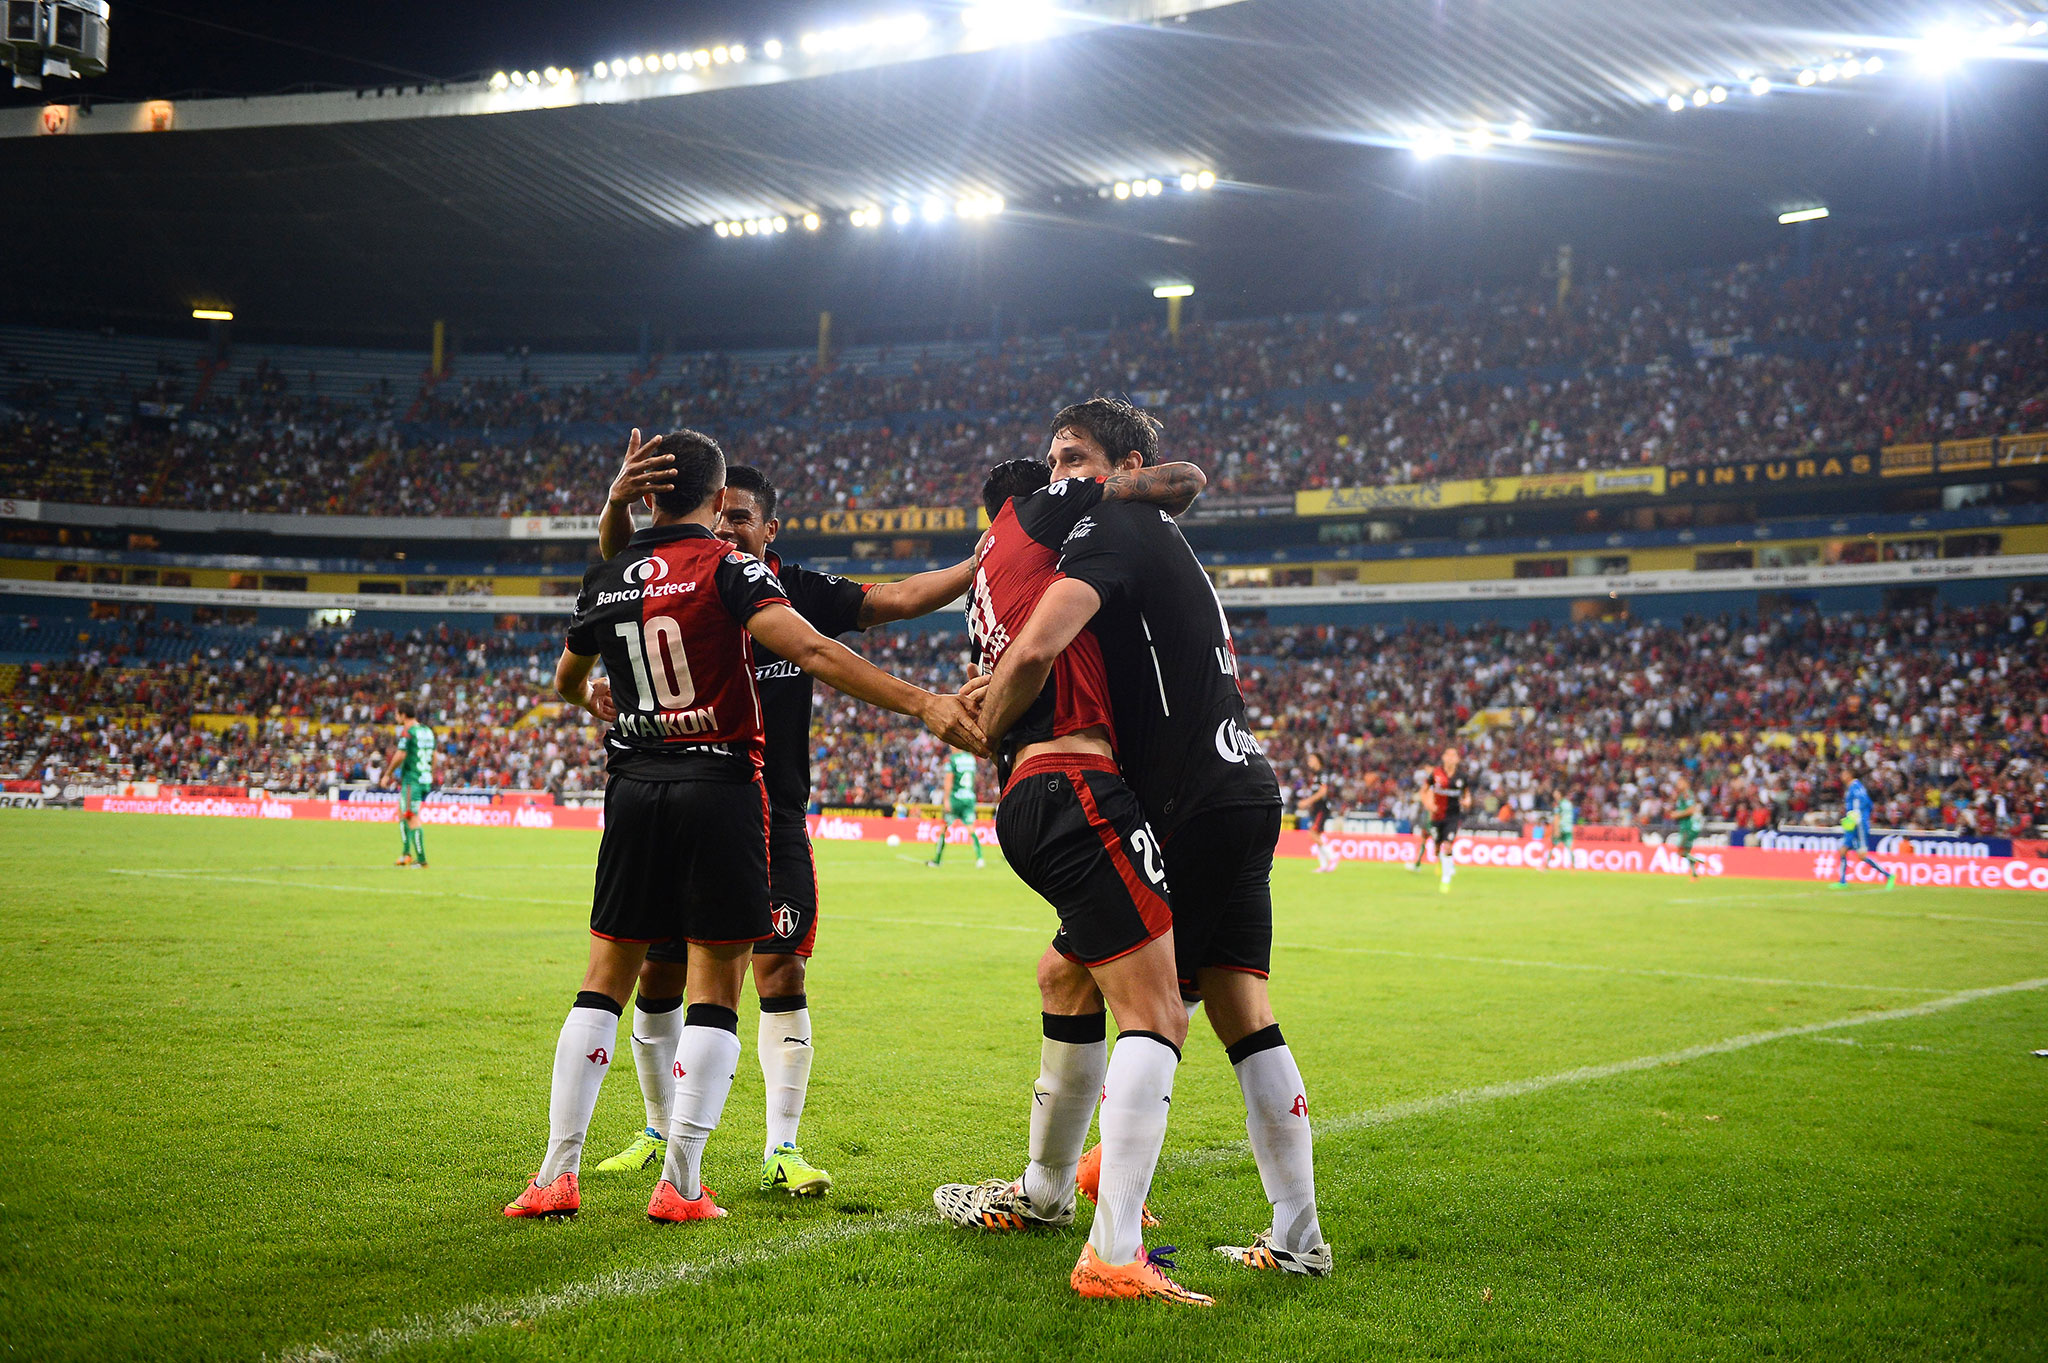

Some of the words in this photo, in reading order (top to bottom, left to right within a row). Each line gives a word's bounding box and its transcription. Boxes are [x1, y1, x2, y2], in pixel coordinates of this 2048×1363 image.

[820, 508, 966, 533] CASTHER
[596, 588, 640, 606] Banco
[641, 580, 696, 598] Azteca
[614, 615, 696, 712] 10
[617, 706, 718, 737] MAIKON
[513, 806, 553, 828] Atlas
[815, 817, 863, 839] Atlas
